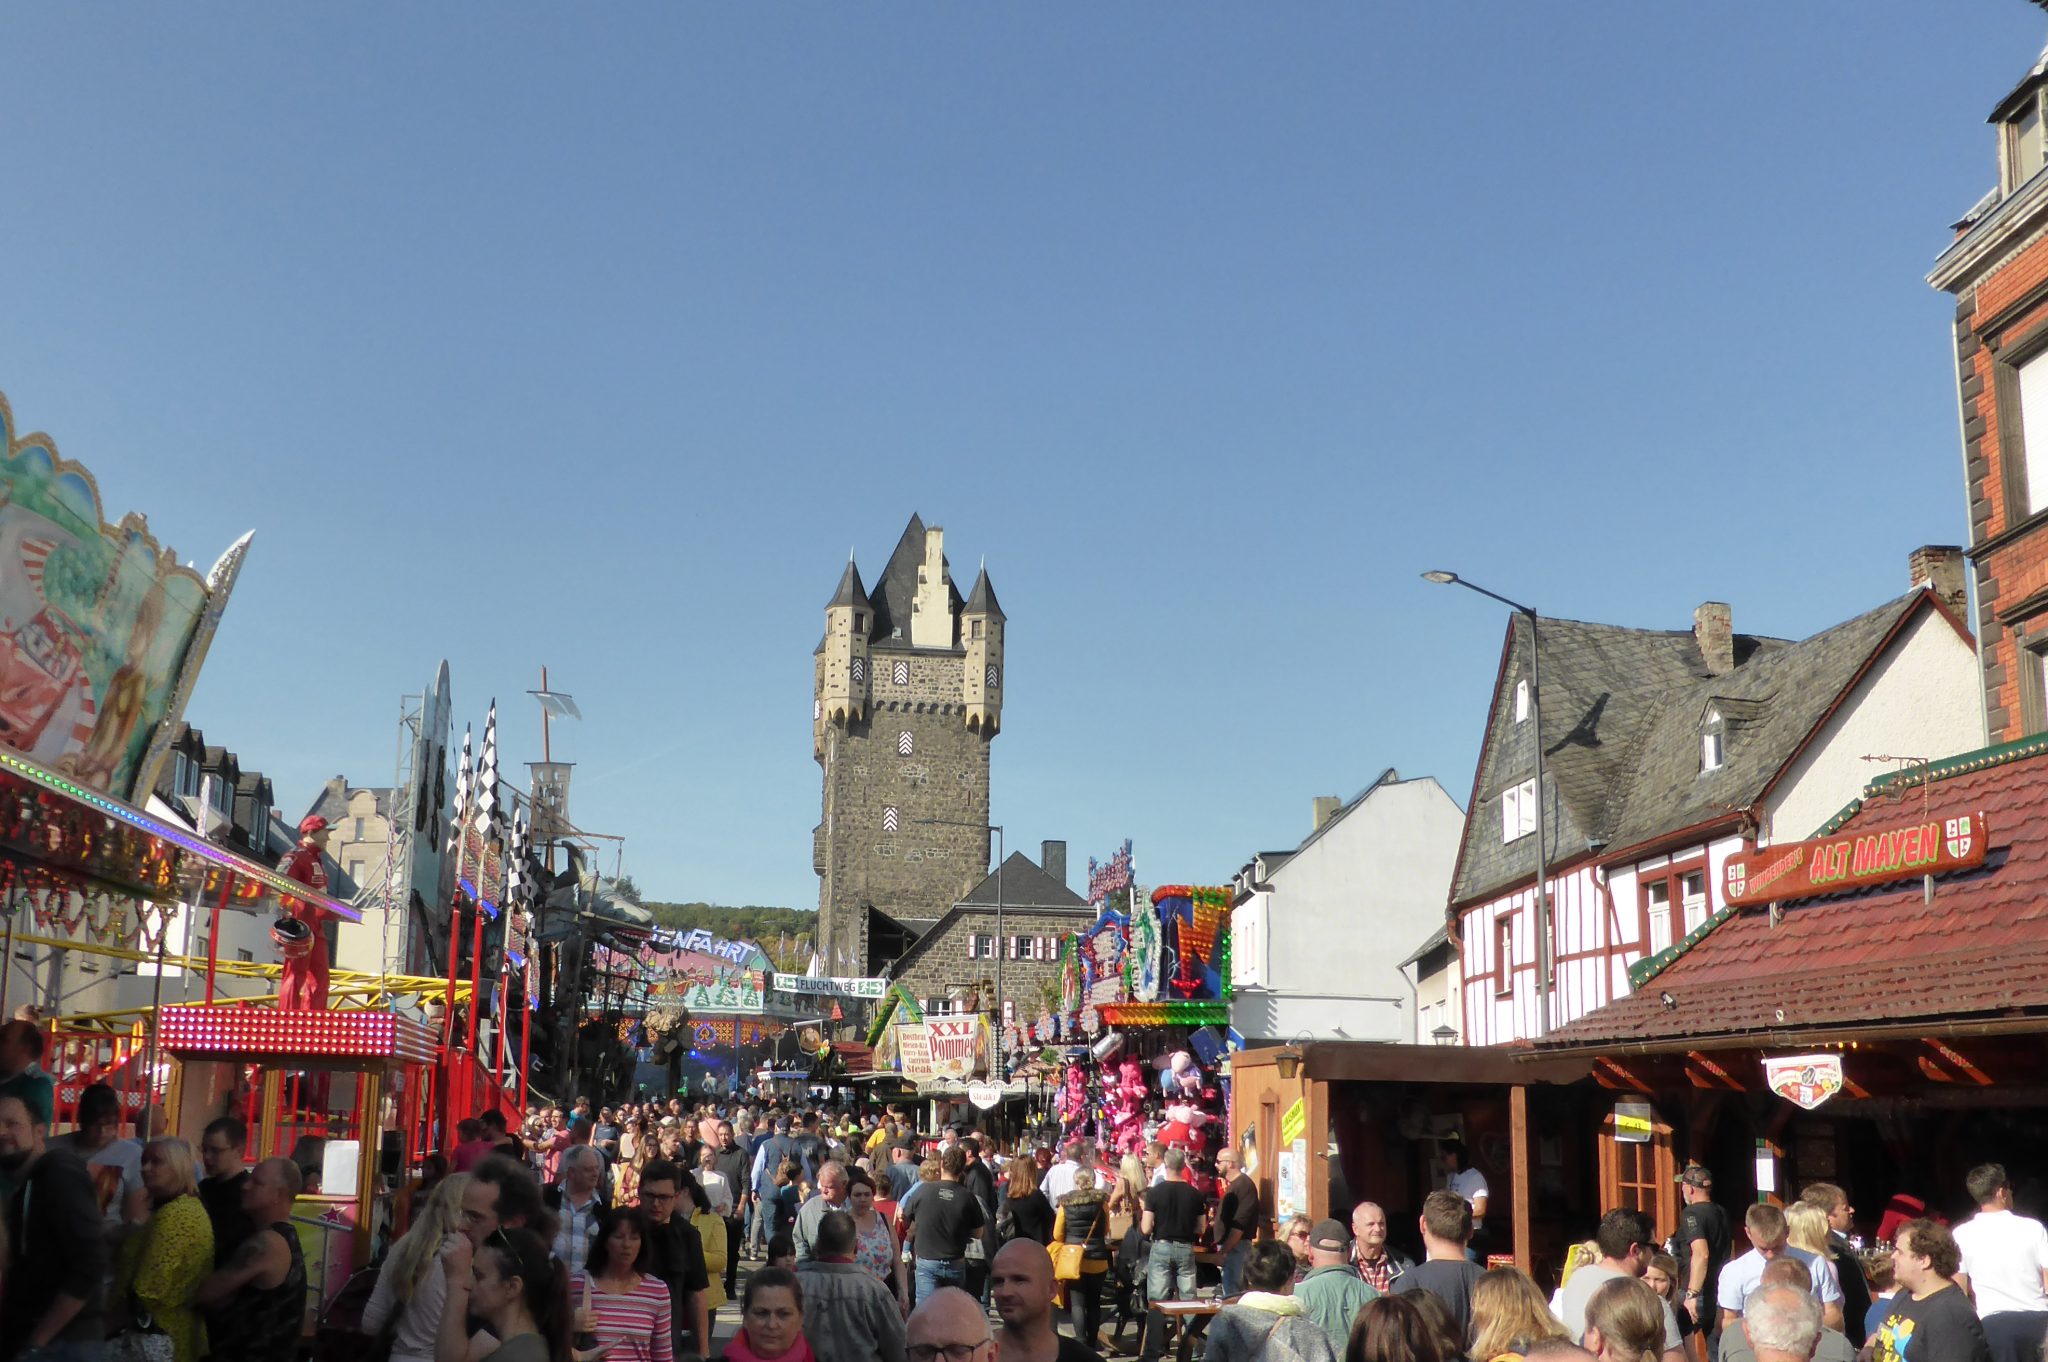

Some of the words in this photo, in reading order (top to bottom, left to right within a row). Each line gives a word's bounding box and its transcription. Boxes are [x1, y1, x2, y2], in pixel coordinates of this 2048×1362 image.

[1749, 846, 1803, 894] WINGENDER'S
[1810, 841, 1850, 883] ALT
[1853, 823, 1940, 877] MAYEN
[800, 979, 856, 992] FLUCHTWEG
[928, 1022, 974, 1037] XXL
[928, 1036, 975, 1062] Pommes
